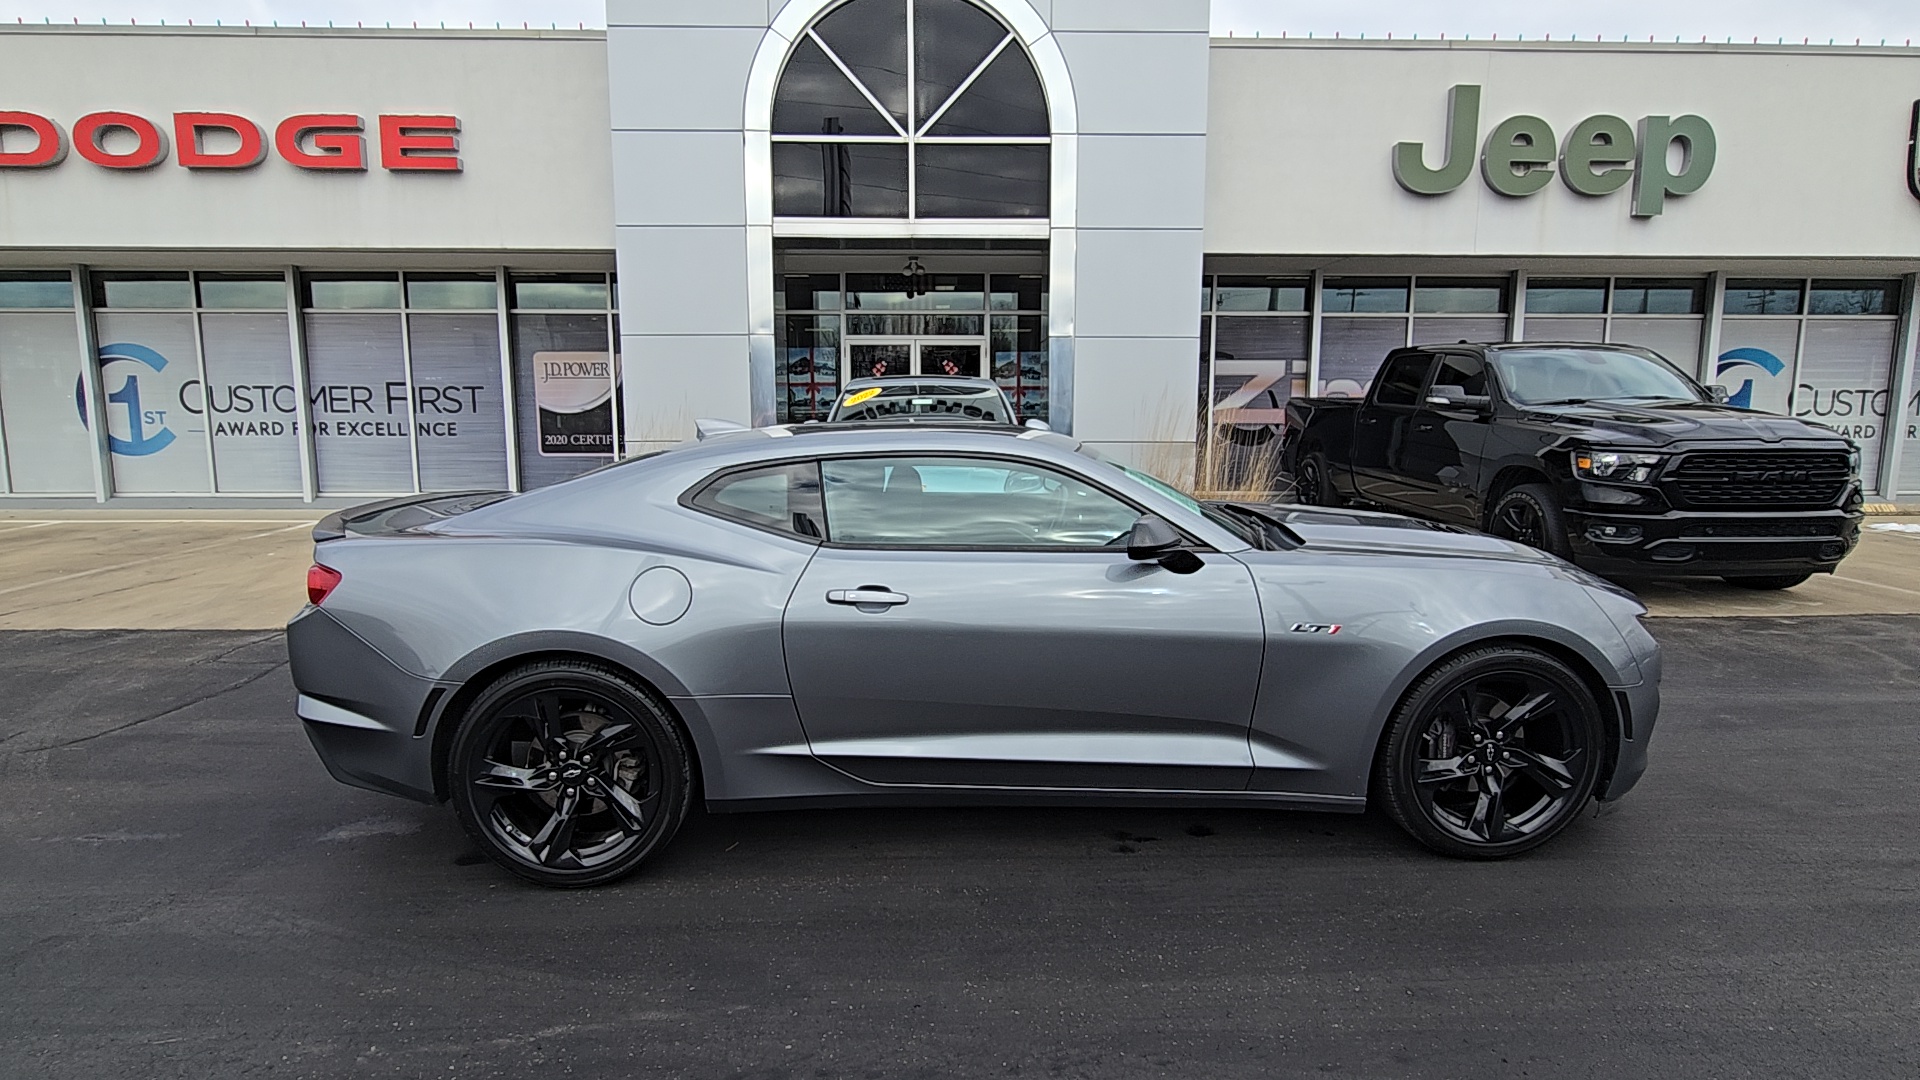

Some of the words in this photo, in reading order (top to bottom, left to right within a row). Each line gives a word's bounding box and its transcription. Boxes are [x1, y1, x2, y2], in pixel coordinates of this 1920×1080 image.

[0, 111, 464, 172] DODGE
[1391, 84, 1717, 218] Jeep
[563, 362, 611, 376] POWER
[385, 381, 484, 414] FIRST
[214, 422, 284, 436] AWARD
[292, 422, 330, 436] FR
[337, 422, 458, 437] EXCELLNCE
[1829, 425, 1876, 439] ARD
[545, 434, 568, 445] 2020
[1862, 503, 1897, 512] SITOR
